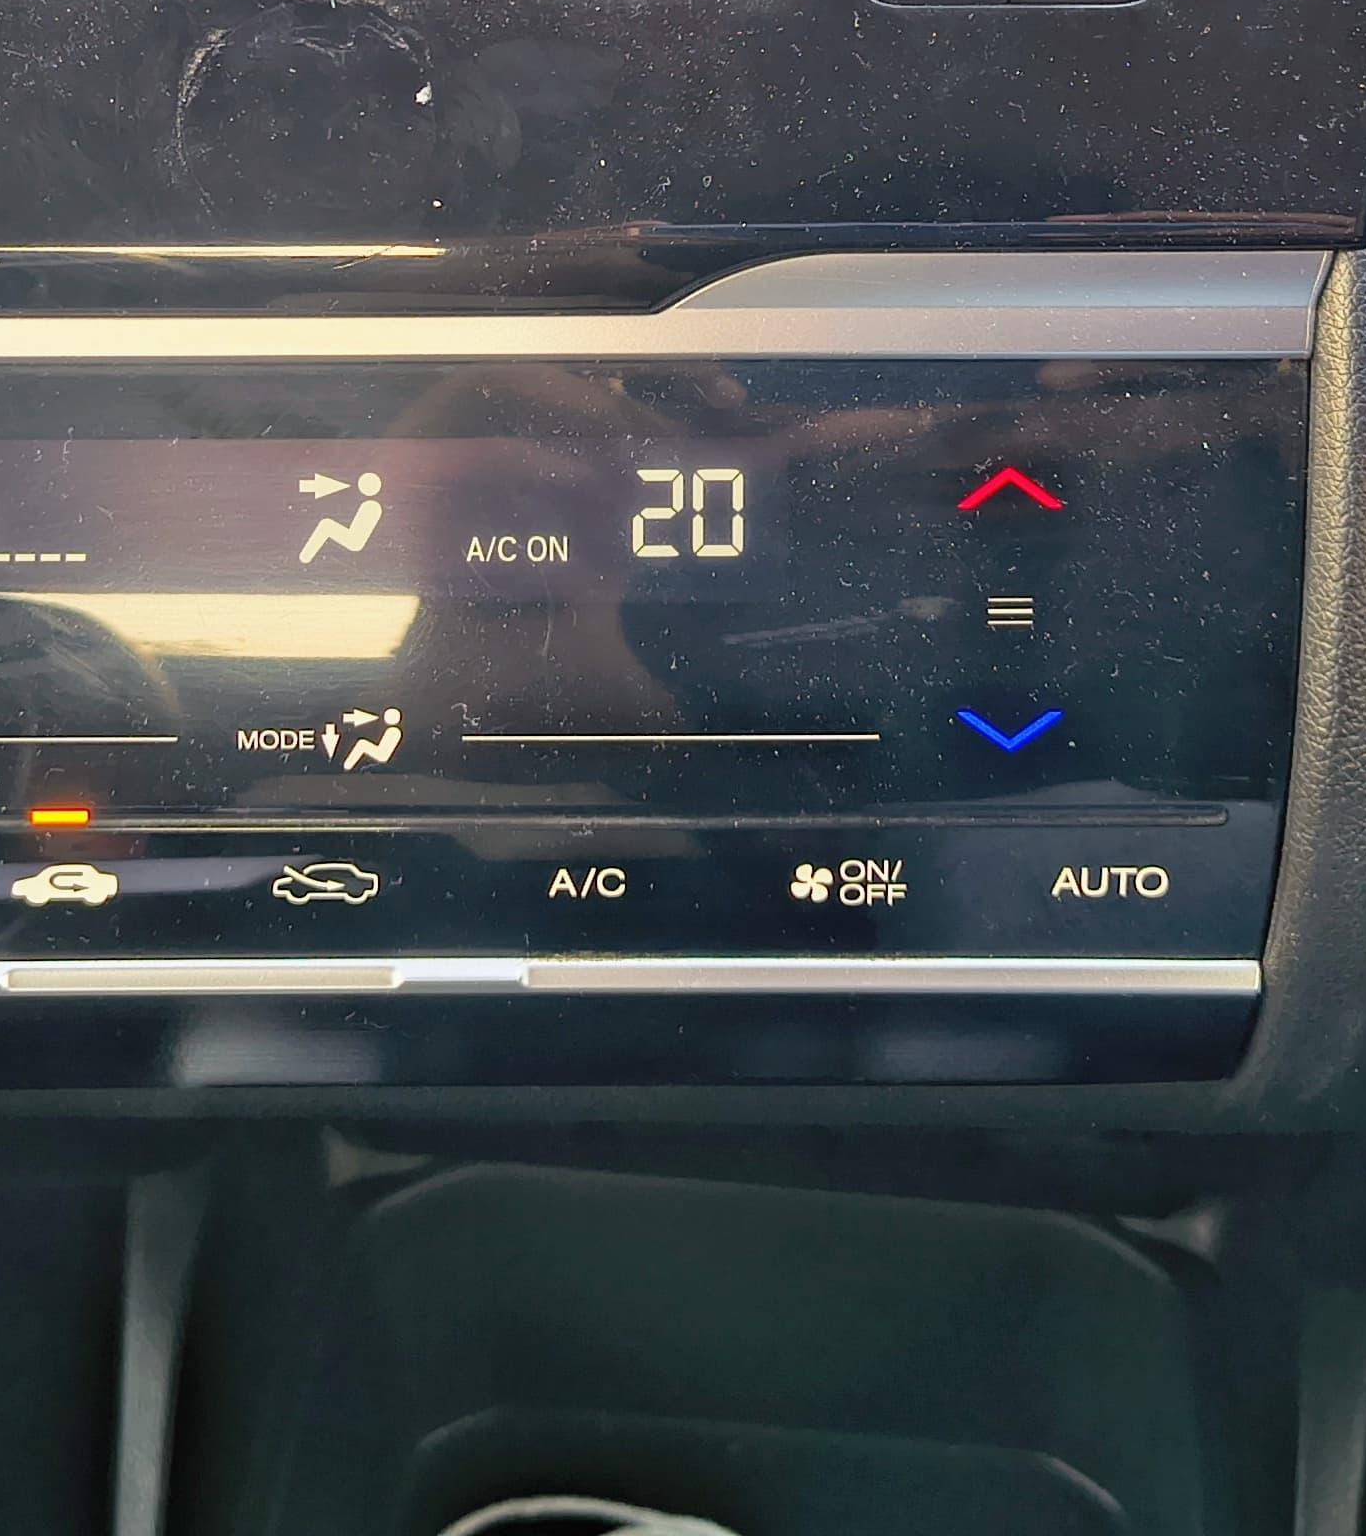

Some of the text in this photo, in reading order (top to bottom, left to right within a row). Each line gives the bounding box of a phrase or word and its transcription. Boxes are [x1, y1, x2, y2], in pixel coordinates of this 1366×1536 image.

[633, 468, 744, 558] 20
[466, 535, 568, 562] A/C ON
[237, 729, 315, 750] MODE
[548, 867, 626, 898] A/C
[839, 859, 902, 882] ON/
[1051, 866, 1169, 898] AUTO
[839, 883, 907, 906] OFF
